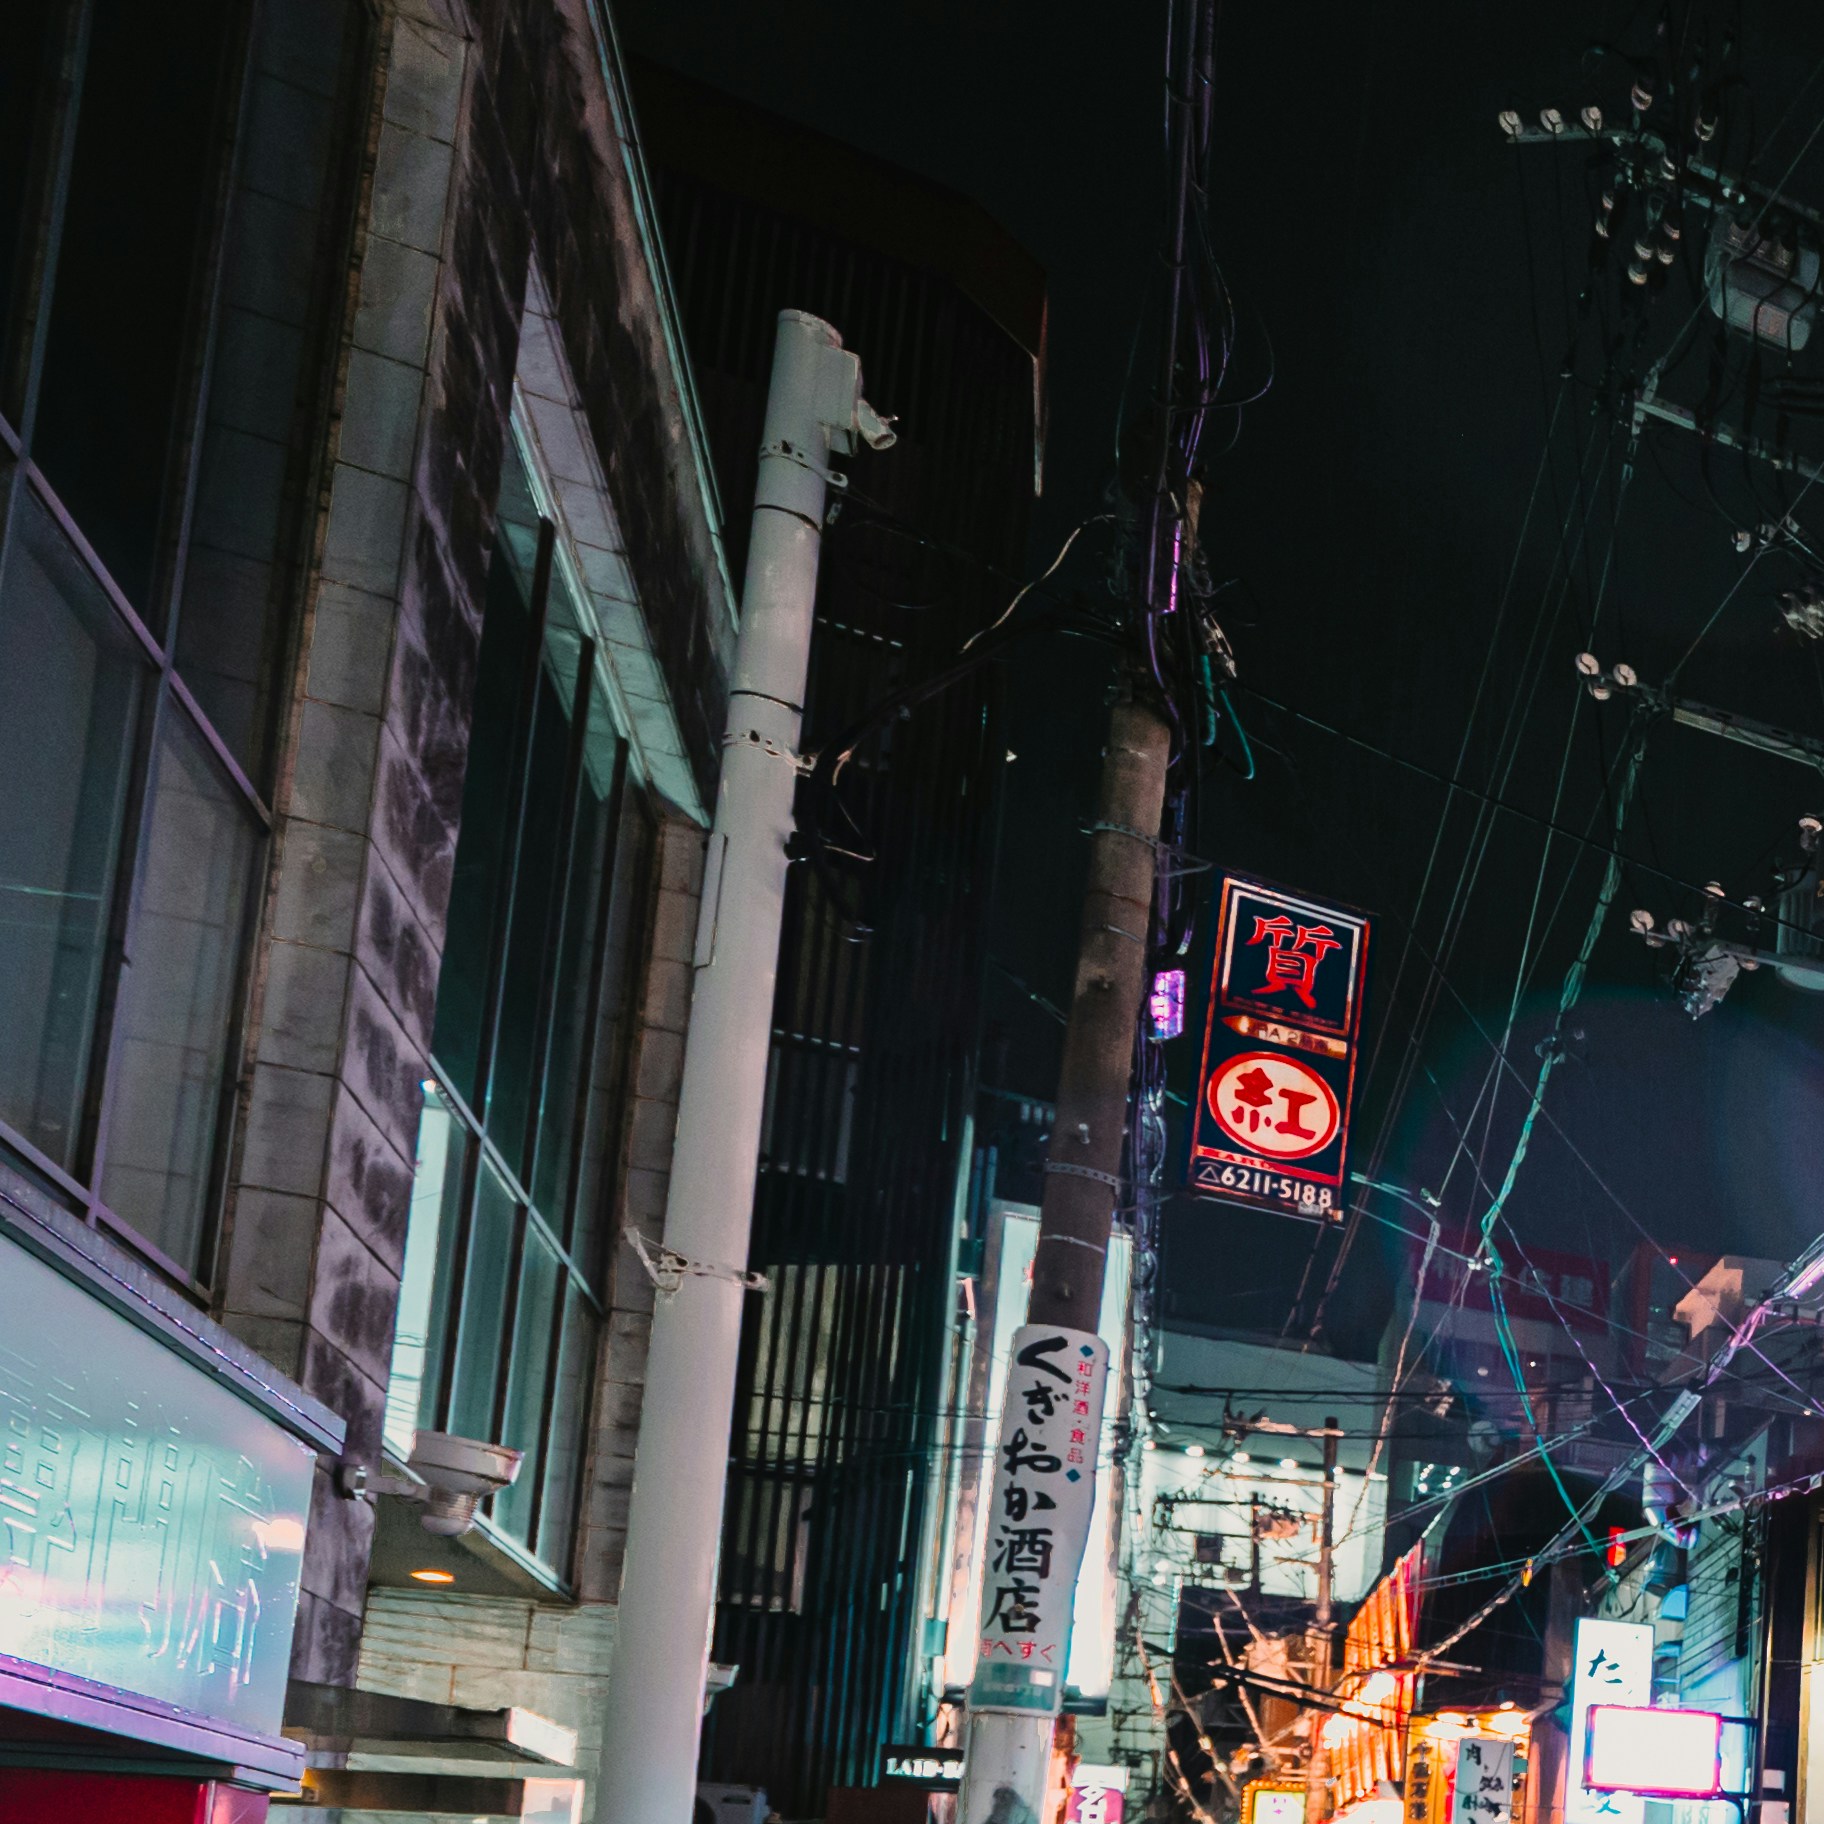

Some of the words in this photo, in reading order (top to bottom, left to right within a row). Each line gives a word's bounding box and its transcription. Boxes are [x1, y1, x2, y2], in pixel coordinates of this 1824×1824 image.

[1245, 914, 1343, 1009] 質
[1231, 1067, 1318, 1141] 紅
[983, 1335, 1072, 1634] くぎおか酒店
